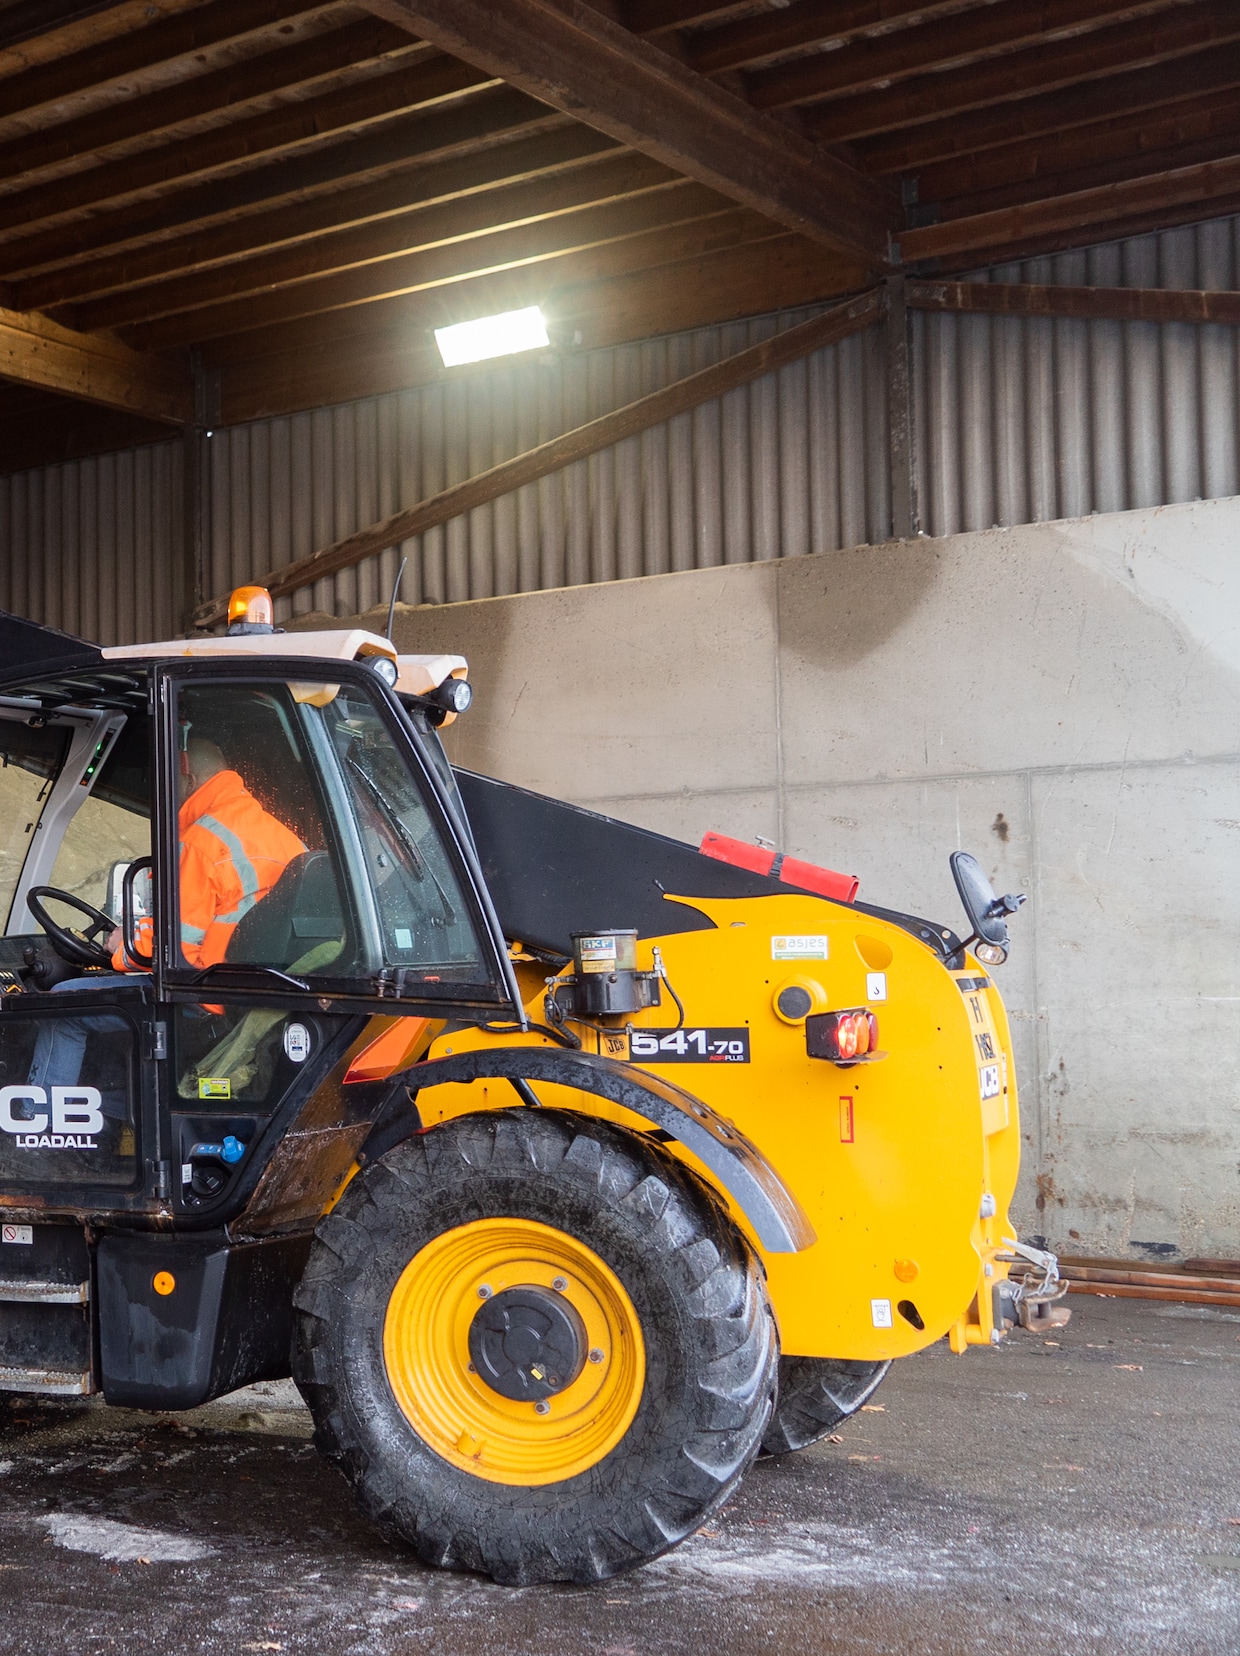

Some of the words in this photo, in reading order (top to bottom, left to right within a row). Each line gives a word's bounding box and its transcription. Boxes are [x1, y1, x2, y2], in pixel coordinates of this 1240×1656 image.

[788, 938, 825, 949] asjes
[607, 1038, 625, 1053] JCB
[631, 1030, 744, 1055] 541-70
[979, 1064, 1000, 1099] JCB
[15, 1135, 98, 1149] LOADALL
